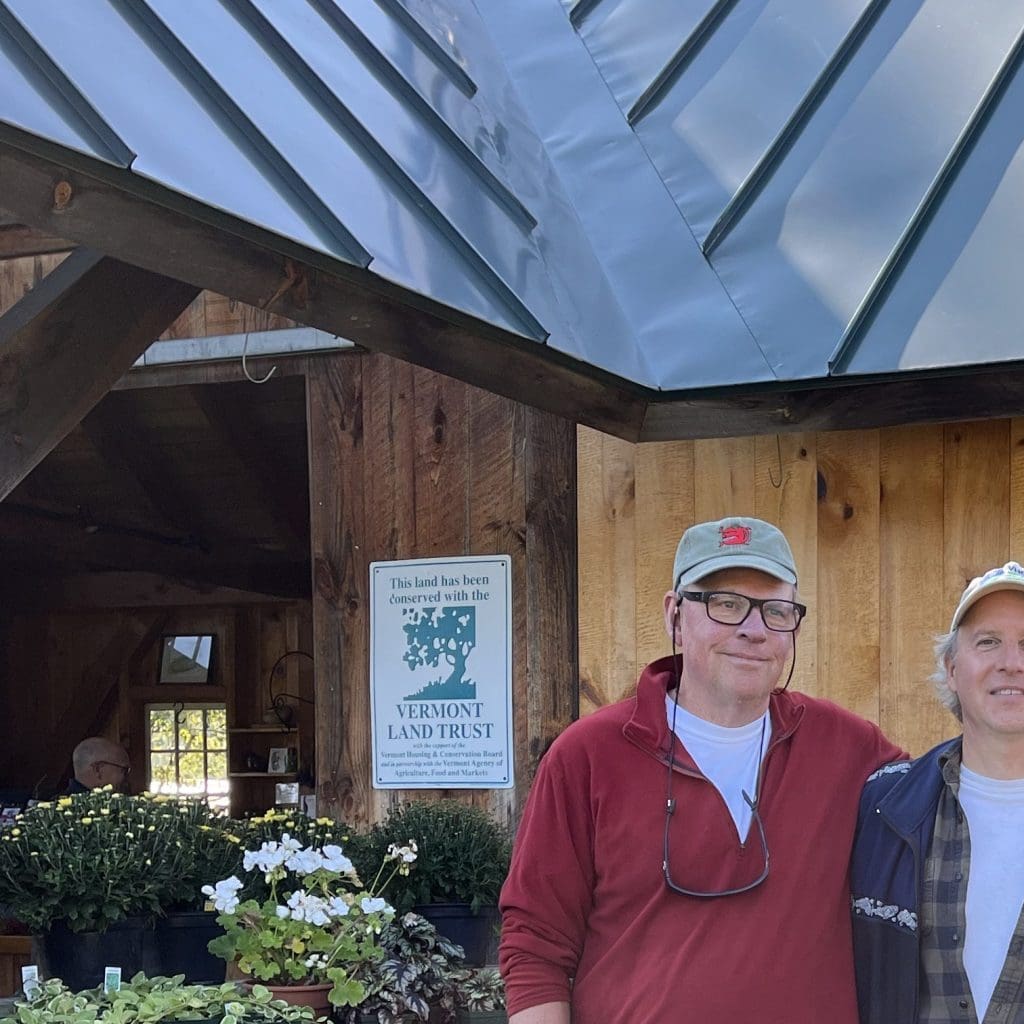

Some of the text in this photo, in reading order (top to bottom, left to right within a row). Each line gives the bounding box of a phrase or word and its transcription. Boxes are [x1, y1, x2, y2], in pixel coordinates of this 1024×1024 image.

[389, 574, 489, 589] This land has been
[444, 590, 468, 602] with
[472, 589, 490, 601] the
[396, 702, 484, 719] VERMONT
[388, 723, 494, 740] LAND TRUST
[471, 760, 494, 769] Agency
[431, 769, 446, 777] Food
[448, 769, 460, 777] and
[461, 769, 488, 777] Markets
